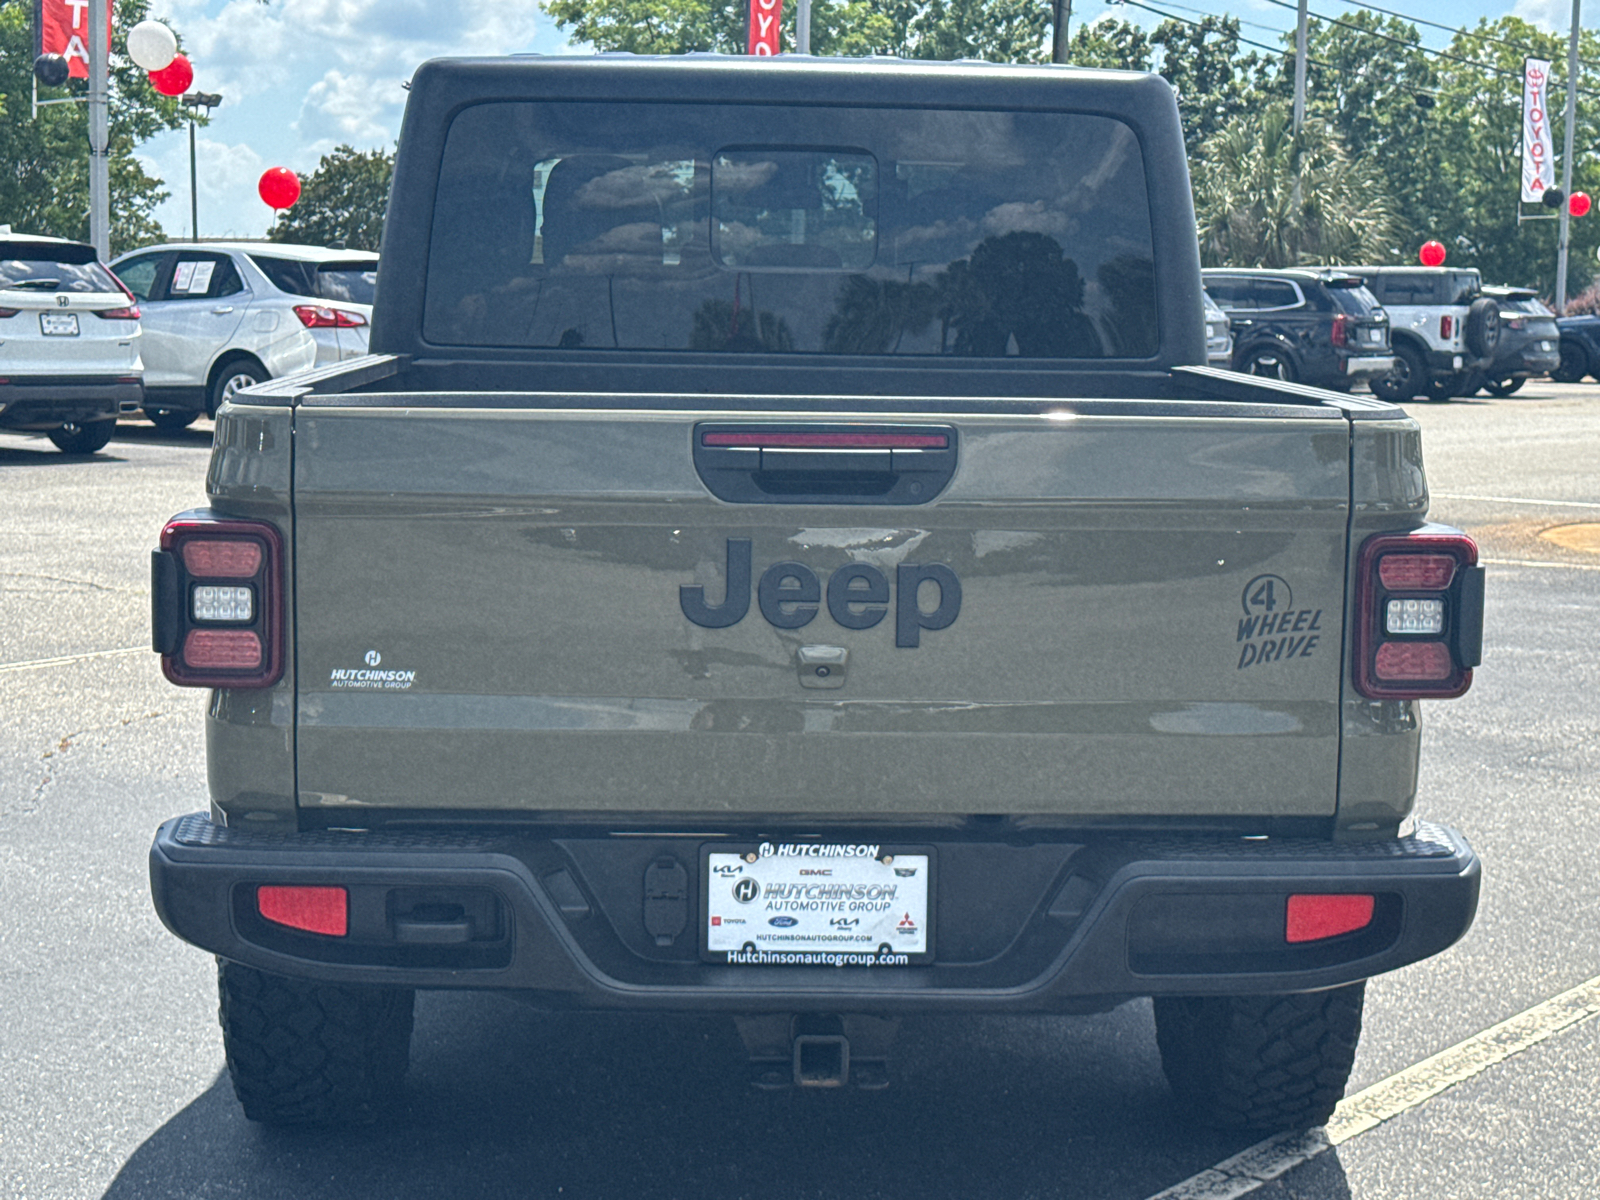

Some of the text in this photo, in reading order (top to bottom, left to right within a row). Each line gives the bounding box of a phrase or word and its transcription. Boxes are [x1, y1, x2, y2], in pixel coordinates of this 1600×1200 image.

[1530, 91, 1544, 190] TOYOTA
[679, 537, 962, 648] Jeep
[1236, 609, 1322, 642] WHEEL
[1237, 635, 1320, 670] DRIVE
[331, 669, 415, 682] HUTCHINSON
[332, 680, 412, 689] AUTOMOTIVE GROUP
[777, 844, 880, 858] HUTCHINSON
[763, 883, 897, 900] HUTCHINSON
[765, 901, 891, 912] AUTOMOTIVE GROUP
[756, 934, 873, 942] HUTCHINSONAUTOGROUP.COM
[727, 950, 909, 967] Hutchinsonautogroup.com
